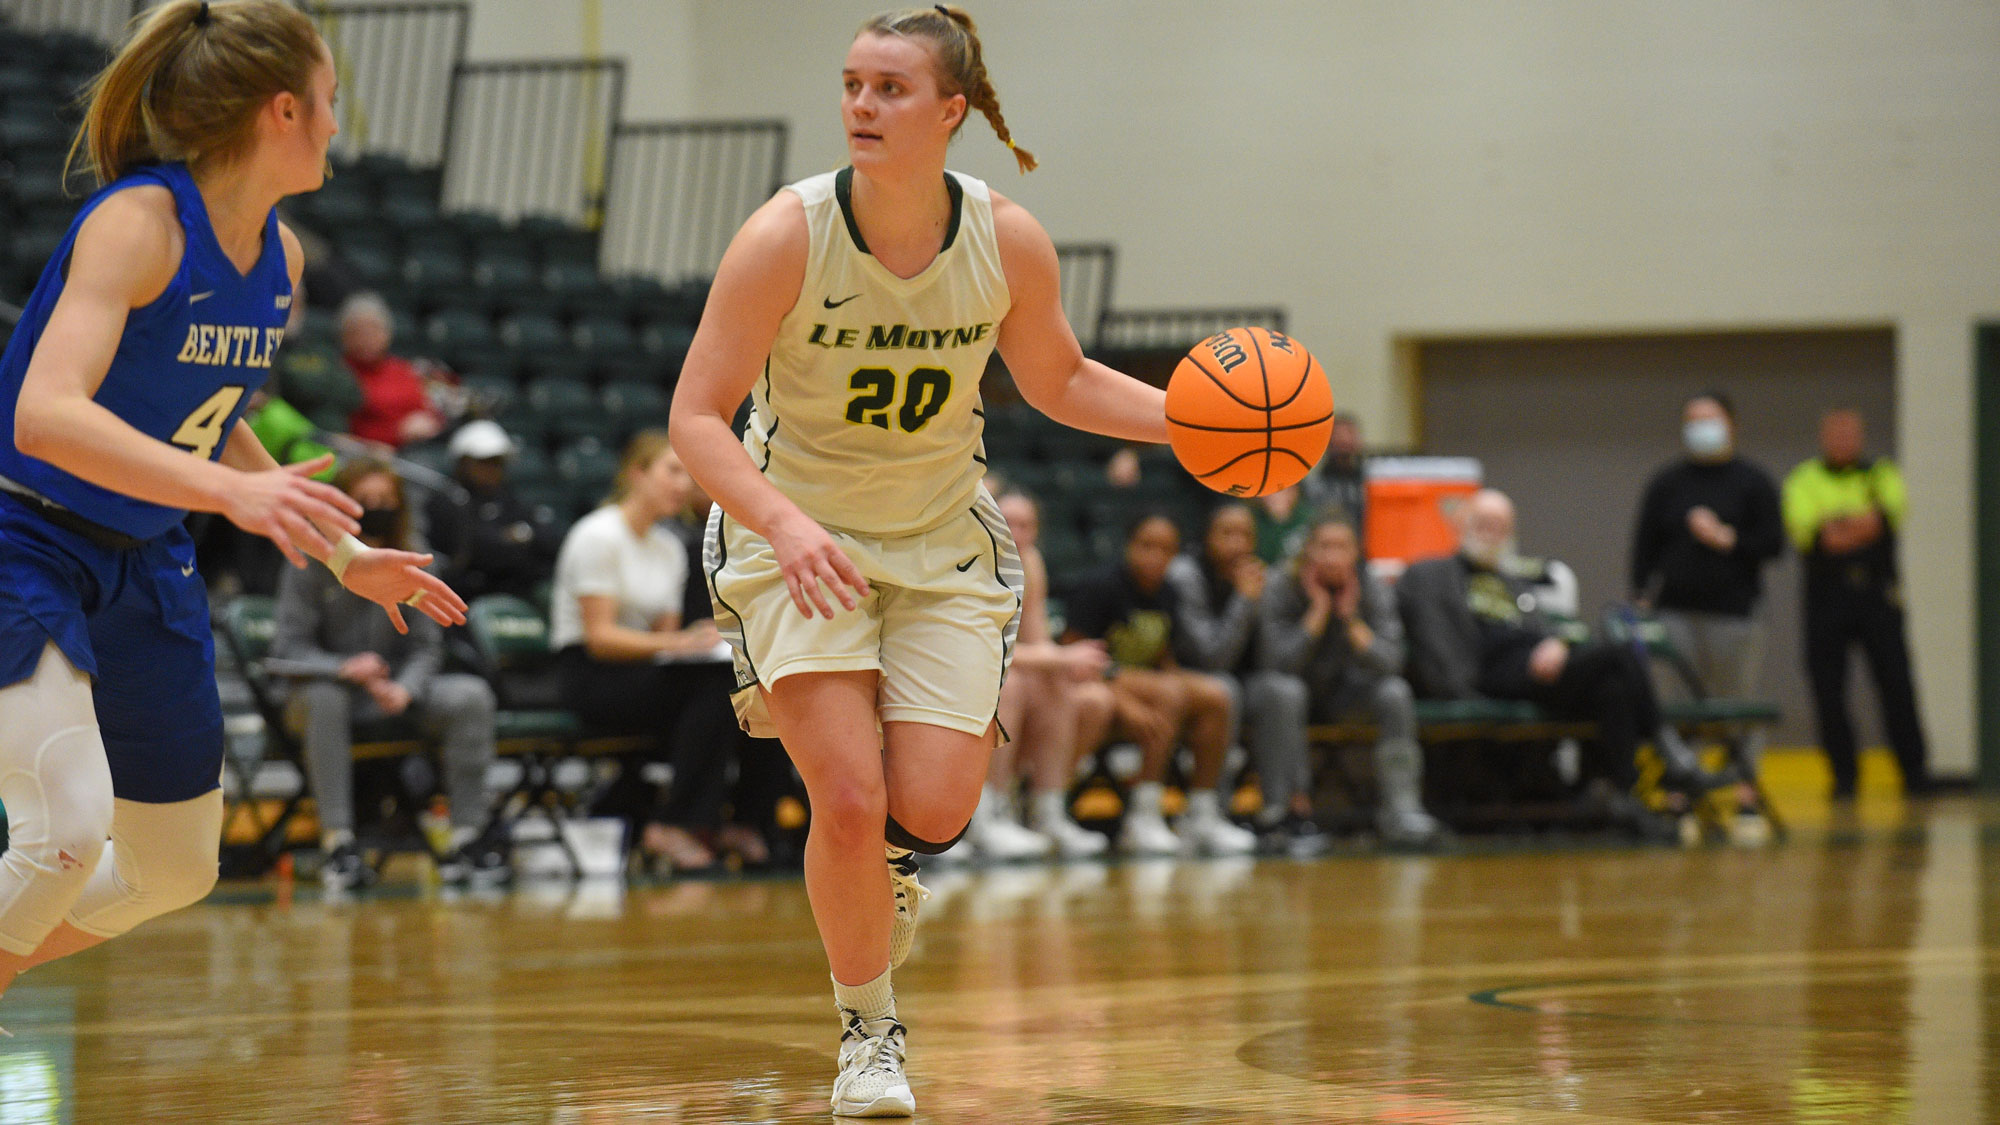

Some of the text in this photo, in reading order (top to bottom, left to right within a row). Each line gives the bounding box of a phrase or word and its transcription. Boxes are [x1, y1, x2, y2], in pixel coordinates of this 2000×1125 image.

[808, 322, 992, 350] LE MOYNE
[170, 385, 246, 460] 4
[845, 365, 954, 434] 20
